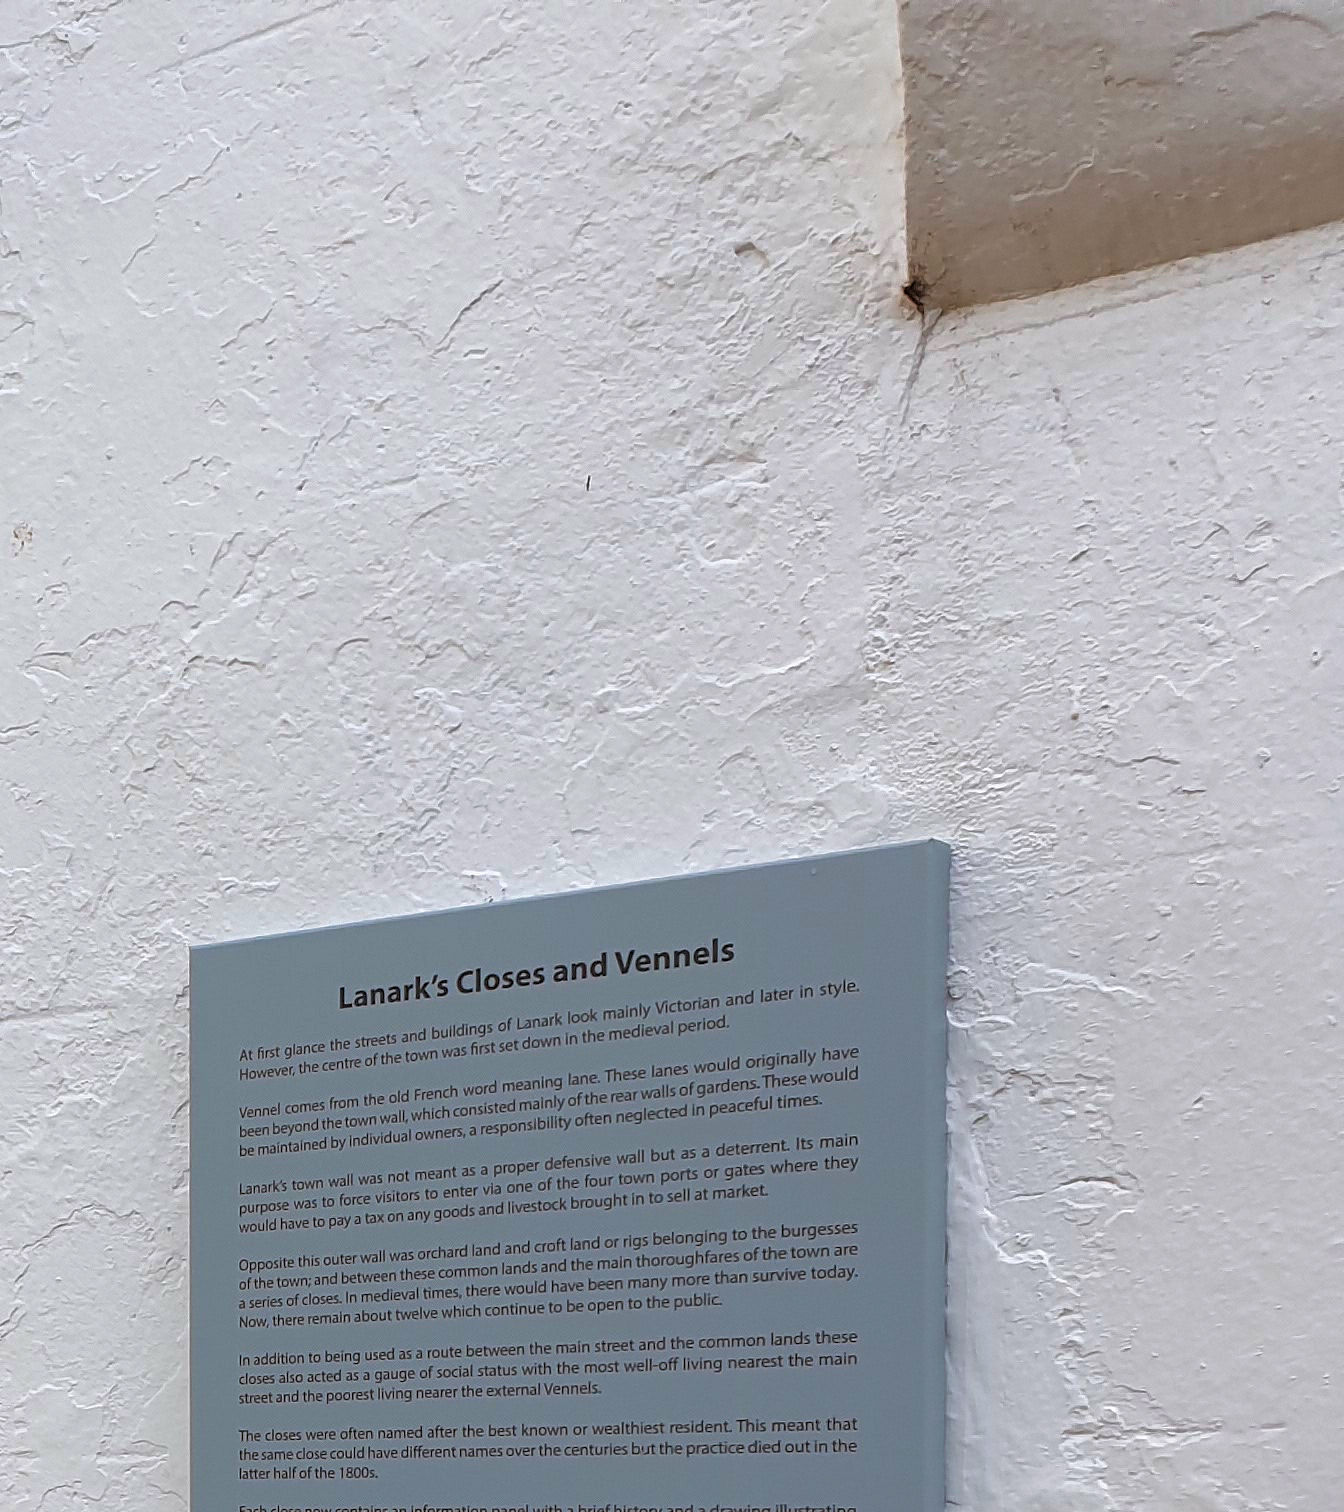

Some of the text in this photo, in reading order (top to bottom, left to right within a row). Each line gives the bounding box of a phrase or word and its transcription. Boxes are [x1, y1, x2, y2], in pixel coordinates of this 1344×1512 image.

[339, 937, 734, 1009] Lanark's Closes and Vennels
[238, 978, 860, 1062] At first glance the streets and buildings of Lanark look mainly Victorian and later in style.
[239, 1014, 730, 1081] However, the centre of the town was first set down in the medieval period.
